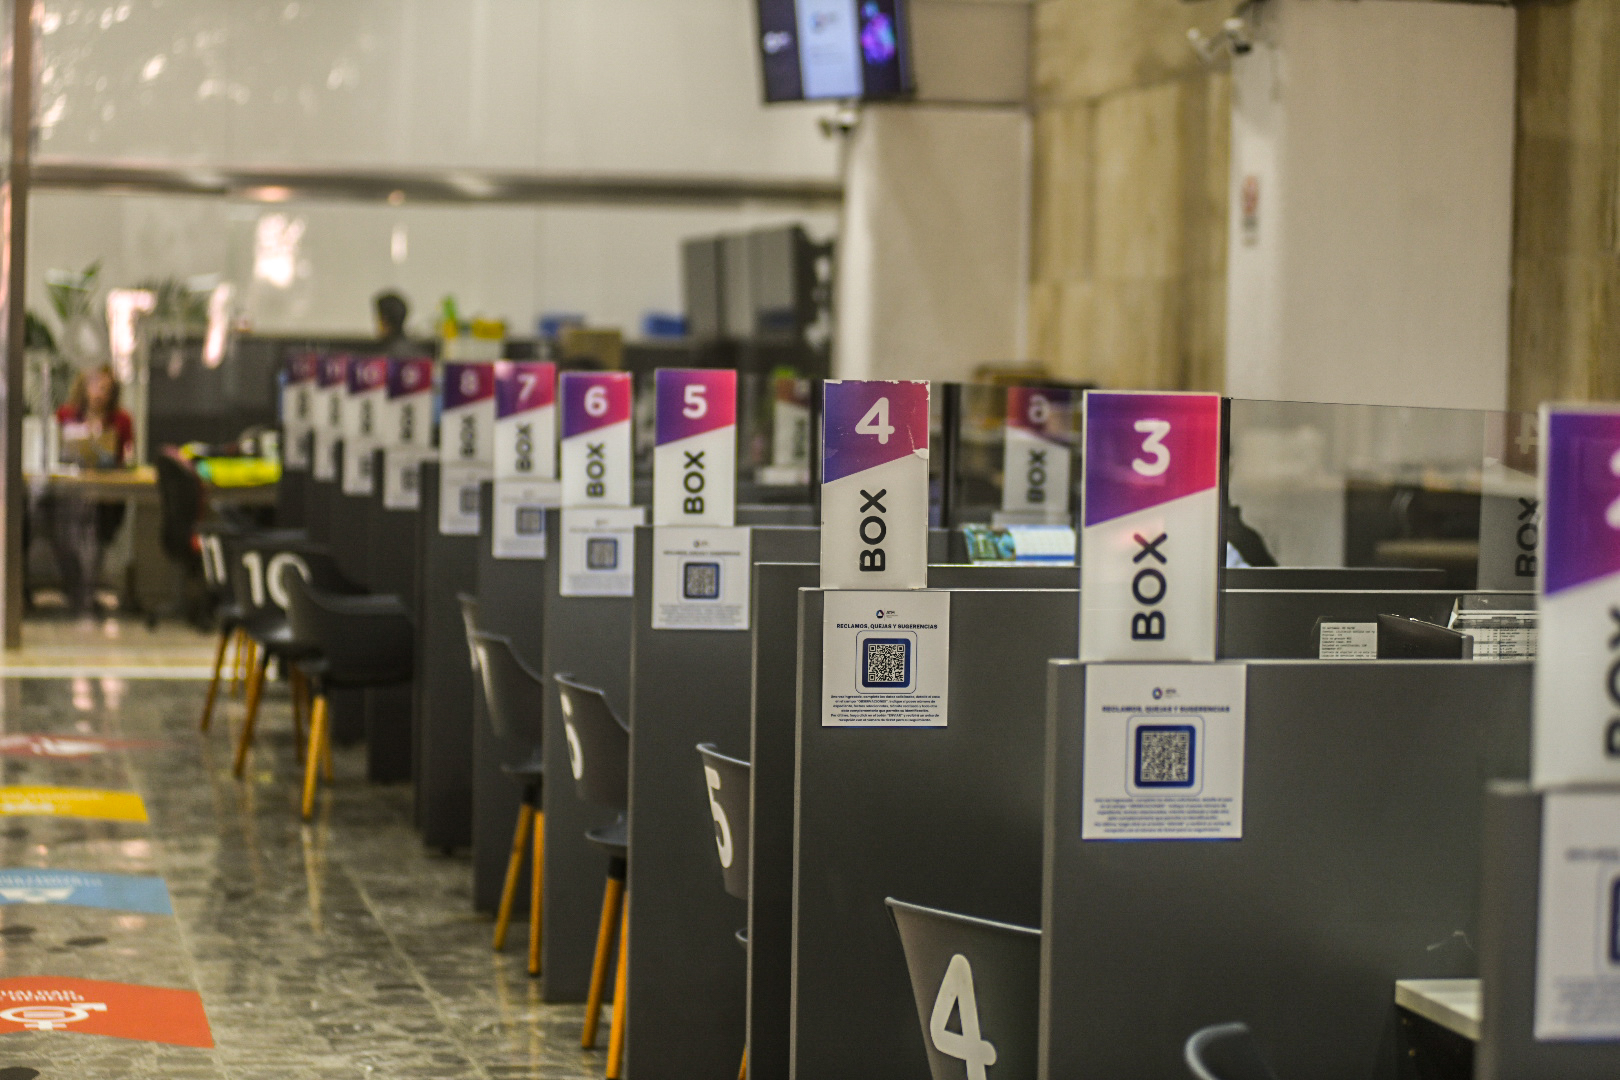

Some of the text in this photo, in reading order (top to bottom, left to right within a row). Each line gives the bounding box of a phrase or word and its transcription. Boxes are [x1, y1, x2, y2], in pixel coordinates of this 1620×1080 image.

[460, 368, 480, 396] 8
[519, 373, 538, 400] 7
[584, 386, 607, 416] 6
[682, 385, 707, 418] 5
[515, 423, 533, 471] BOX
[855, 397, 896, 445] 4
[586, 442, 606, 498] BOX
[1131, 419, 1171, 477] 3
[683, 451, 705, 514] BOX
[859, 489, 887, 572] BOX
[1131, 533, 1168, 641] BOX
[930, 953, 997, 1080] 4
